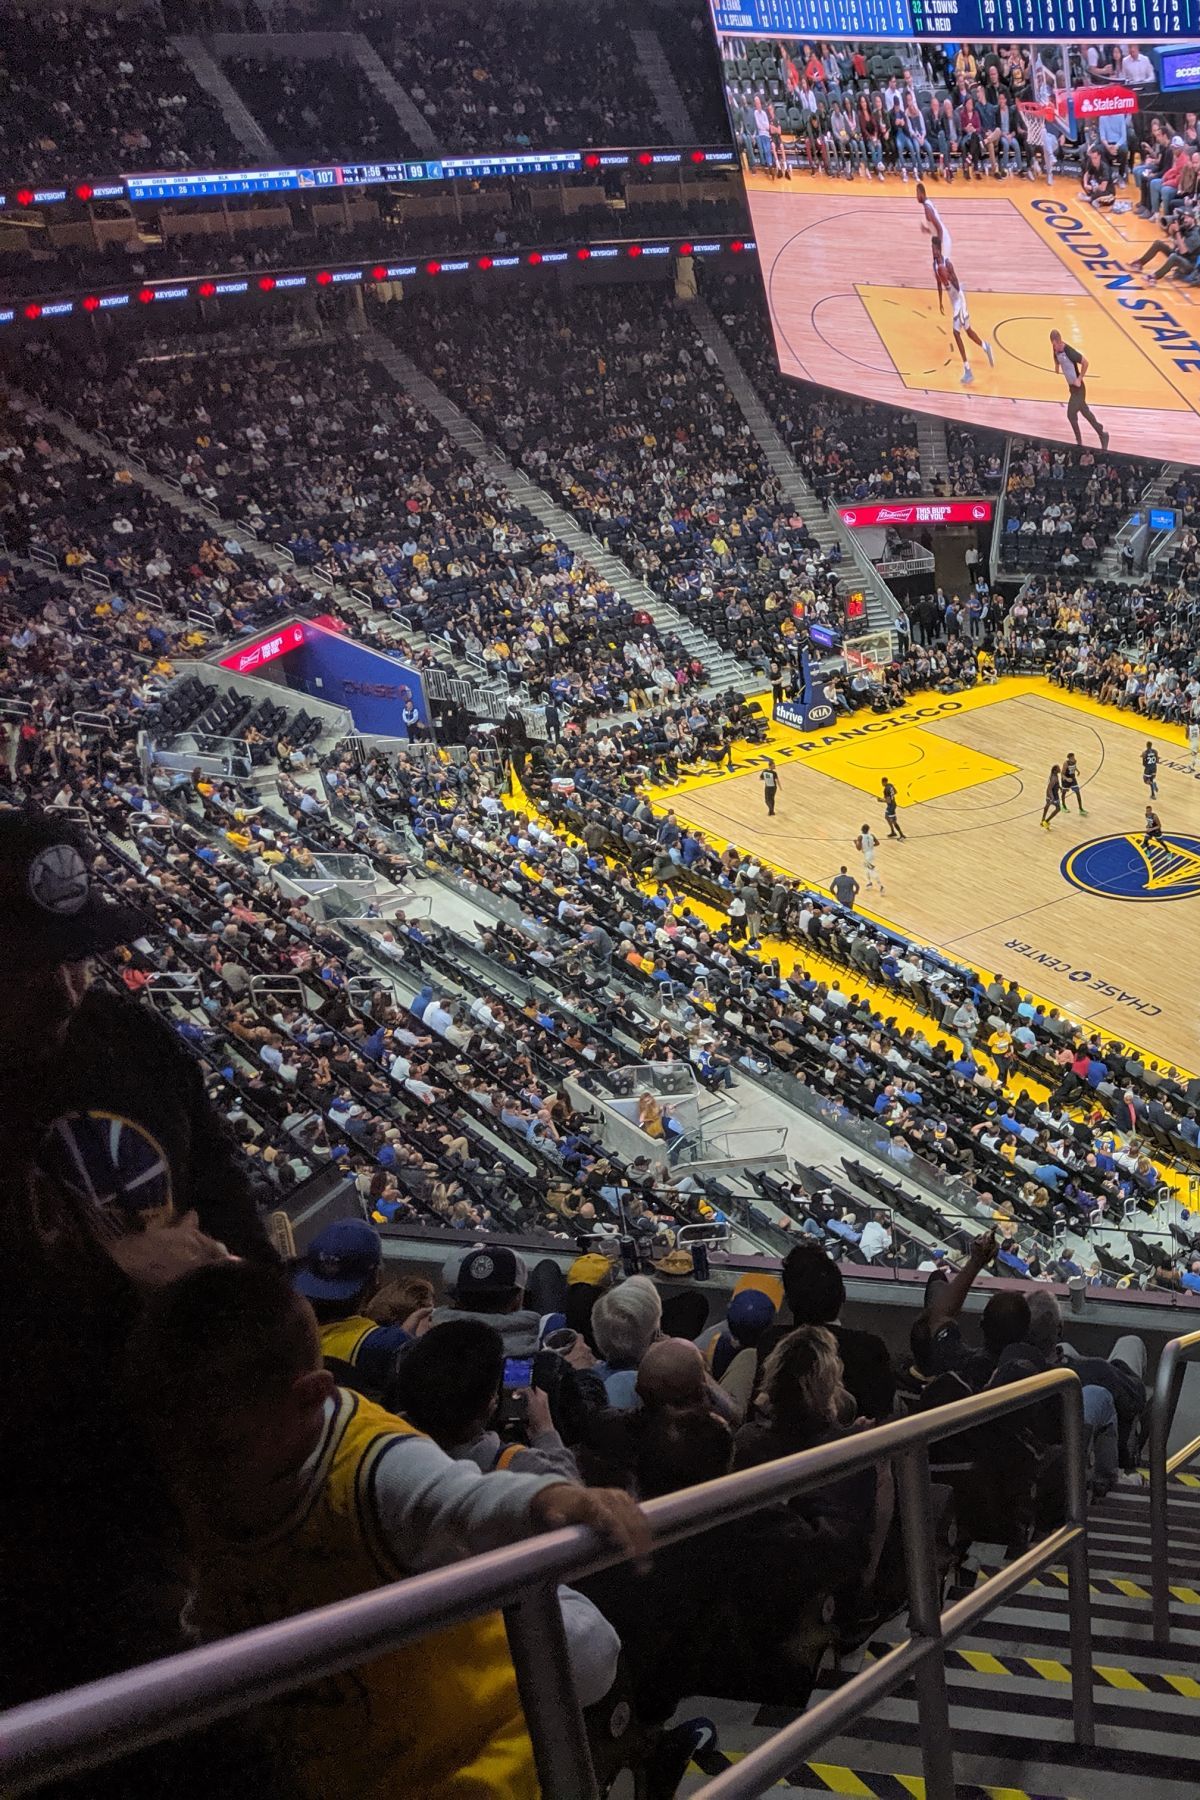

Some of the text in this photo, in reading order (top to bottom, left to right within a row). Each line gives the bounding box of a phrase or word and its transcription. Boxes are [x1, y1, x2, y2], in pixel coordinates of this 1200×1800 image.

[913, 1, 922, 13] 32
[933, 1, 958, 14] TOWNS
[936, 18, 952, 31] REID
[988, 18, 994, 32] 7
[1008, 17, 1014, 32] 8
[1028, 17, 1034, 32] 7
[1048, 17, 1055, 32] 0
[1069, 17, 1075, 32] 0
[1090, 17, 1097, 31] 0
[653, 155, 682, 163] KEYSIGHT
[363, 167, 380, 177] 1:56
[410, 166, 422, 178] 99
[317, 172, 333, 184] 107
[34, 192, 66, 201] KEYSIGHT
[93, 187, 125, 197] KEYSIGHT
[1030, 199, 1146, 291] GOLDEN
[276, 278, 307, 287] KEYSIGHT
[333, 273, 363, 282] KEYSIGHT
[216, 283, 248, 293] KEYSIGHT
[155, 289, 188, 299] KEYSIGHT
[100, 296, 129, 307] KEYSIGHT
[42, 304, 73, 315] KEYSIGHT
[776, 706, 803, 725] thrive
[812, 708, 828, 719] KIA
[703, 701, 963, 779] SAN FRANCISCO
[1146, 756, 1157, 764] 20
[1004, 938, 1163, 1017] CHASE CENTER
